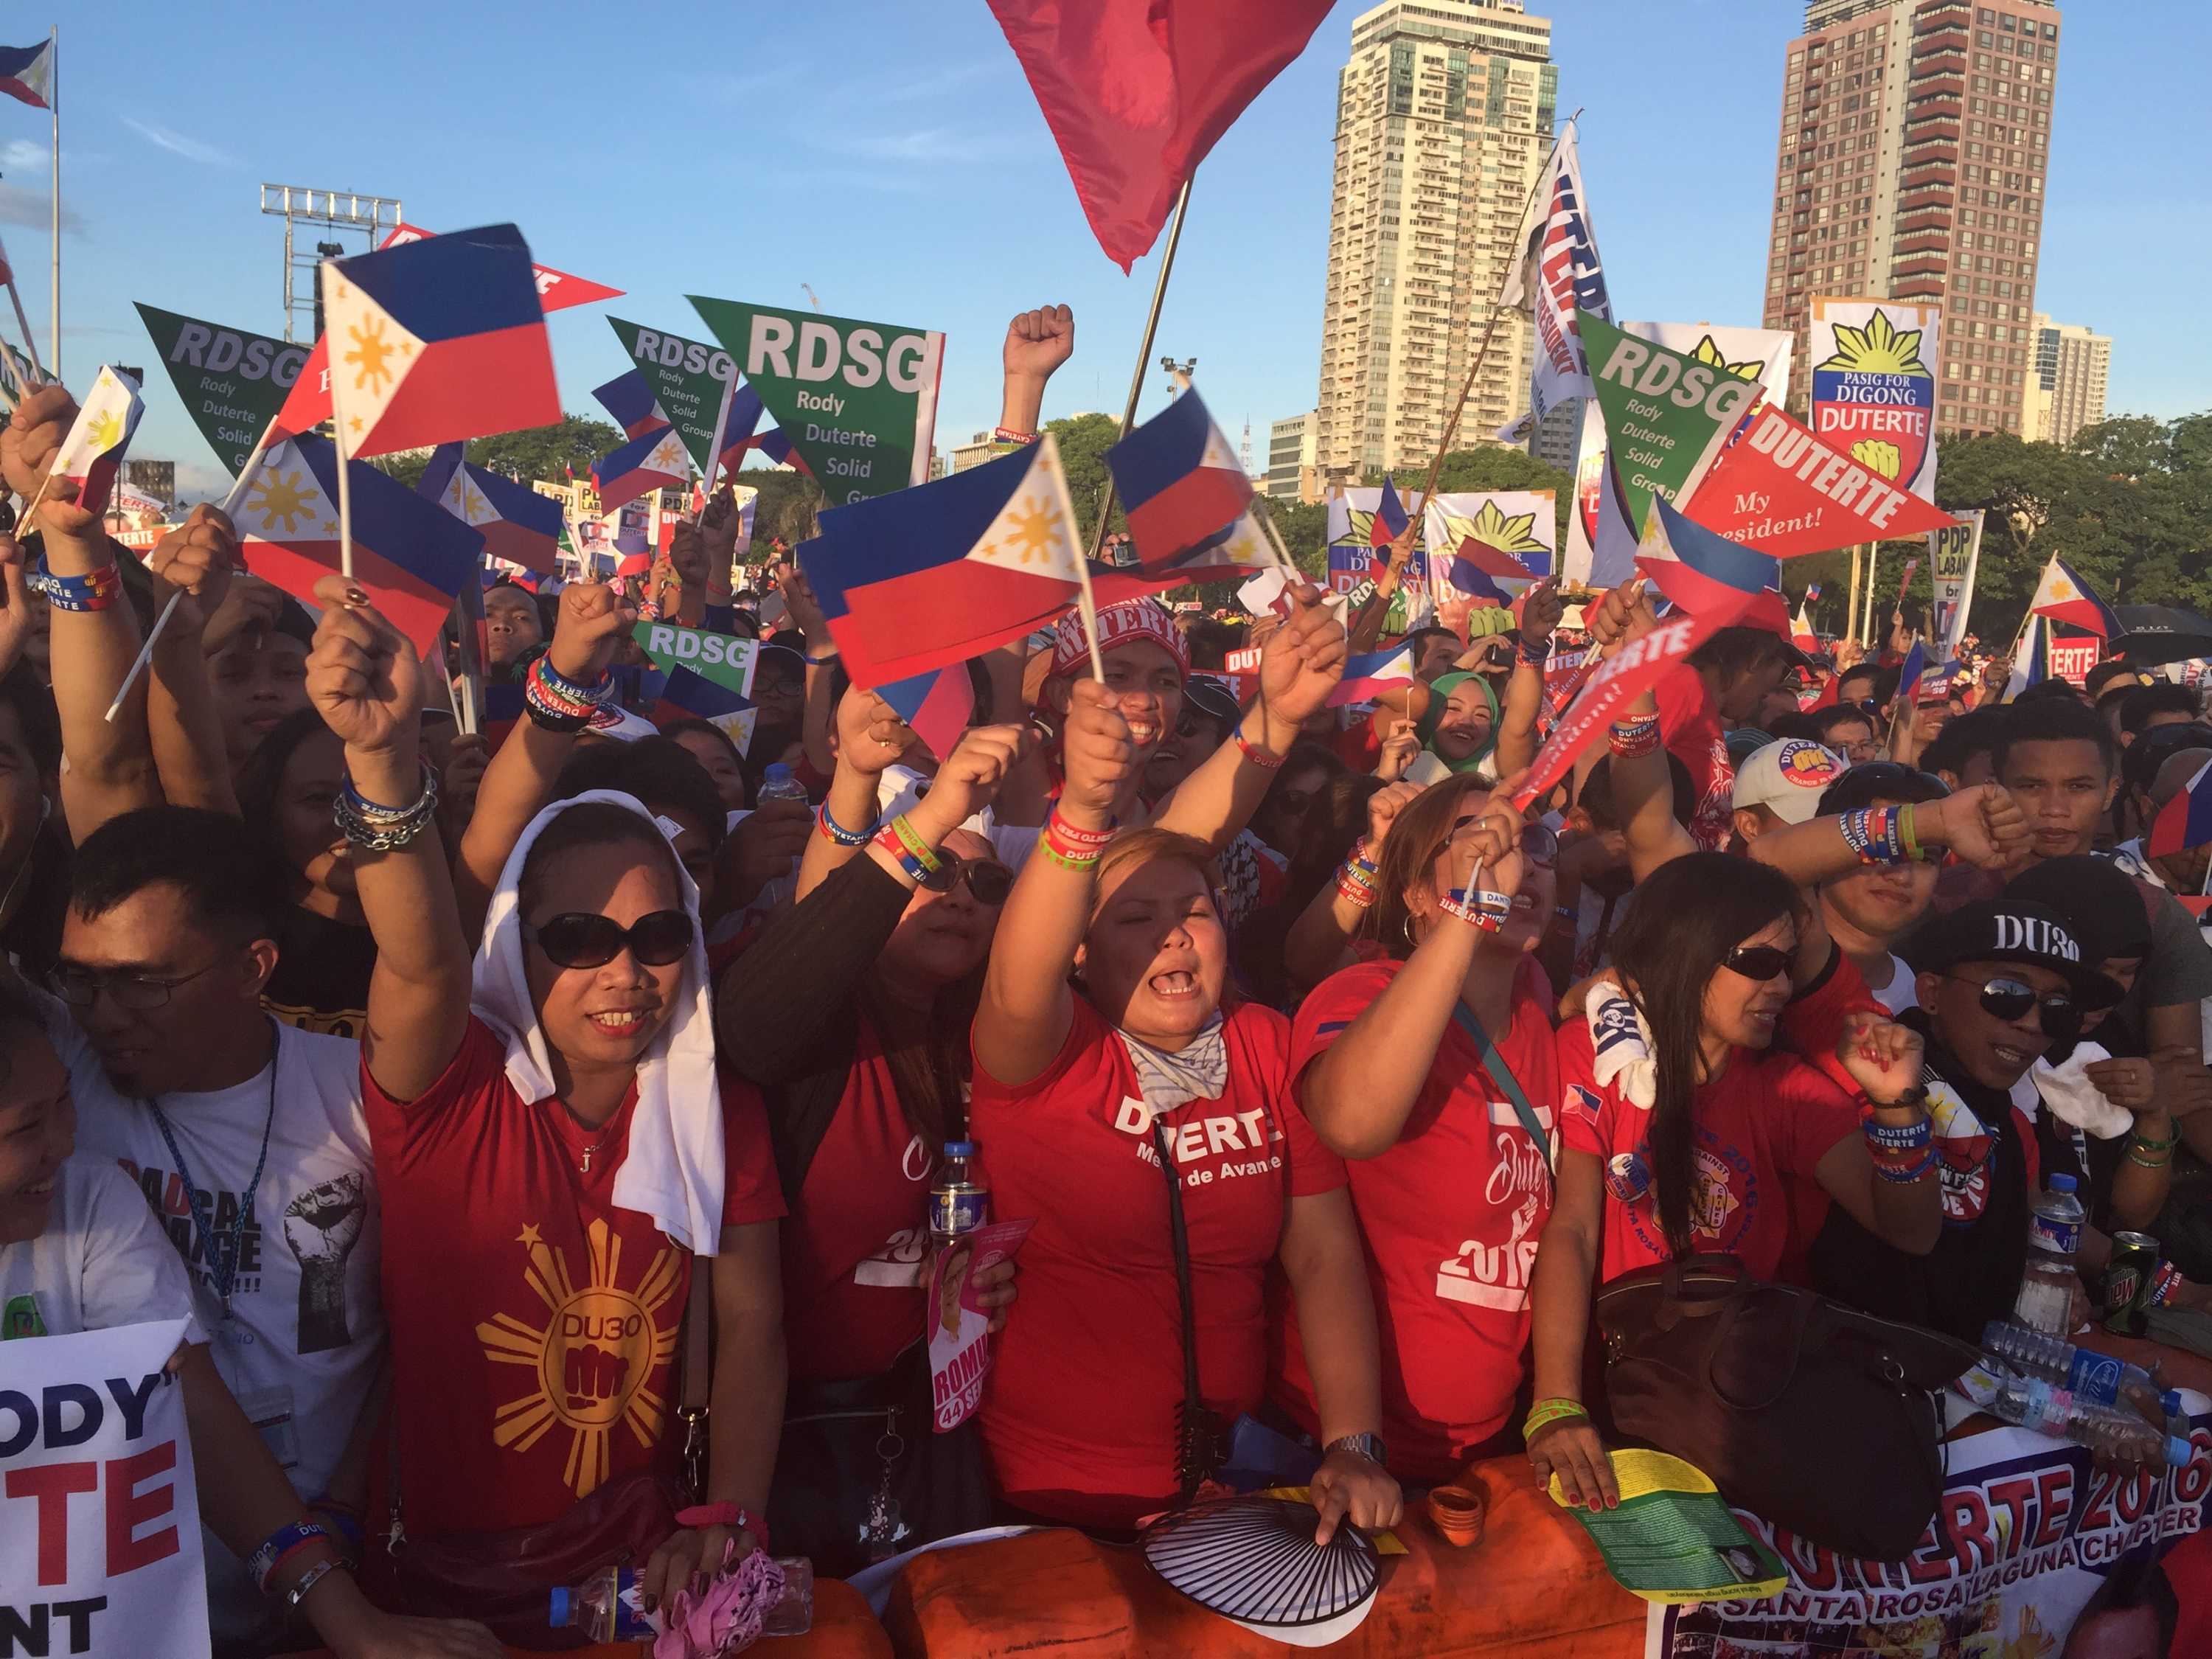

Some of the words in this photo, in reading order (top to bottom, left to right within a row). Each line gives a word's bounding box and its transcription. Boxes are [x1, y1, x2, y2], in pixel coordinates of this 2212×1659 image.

[635, 330, 737, 381] RDSG
[747, 314, 926, 393] RDSG
[201, 377, 236, 397] Rody
[659, 369, 684, 386] Rody
[1599, 338, 1749, 422] RDSG
[1844, 372, 1884, 387] PASIG
[1886, 375, 1911, 388] FOR
[662, 386, 701, 405] Duterte
[797, 391, 845, 417] Rody
[1835, 385, 1917, 406] DIGONG
[203, 400, 256, 422] Duterte
[672, 405, 697, 420] Solid
[1625, 398, 1663, 422] Rody
[1820, 407, 1925, 437] DUTERTE
[218, 426, 252, 445] Solid
[681, 422, 714, 439] Group
[806, 423, 877, 448] Duterte
[1621, 422, 1676, 450] Duterte
[827, 457, 872, 479] Solid
[1624, 447, 1664, 470] Solid
[1747, 411, 1907, 531] DUTERTE
[1734, 490, 1771, 515] My
[1719, 507, 1823, 543] esident!
[1937, 526, 1971, 554] PDP
[649, 625, 751, 668] RDSG
[1878, 1123, 1927, 1137] DUTERTE
[1187, 1169, 1213, 1187] de
[1221, 1155, 1281, 1180] Avane
[1714, 1187, 1725, 1224] CRIMES
[563, 1313, 641, 1340] DU30
[942, 1402, 962, 1424] 44
[1722, 1589, 1861, 1621] SANTA
[1877, 1579, 1969, 1618] ROSA
[1972, 1546, 2073, 1600] LAGUNA
[2085, 1507, 2198, 1559] CHAPTER
